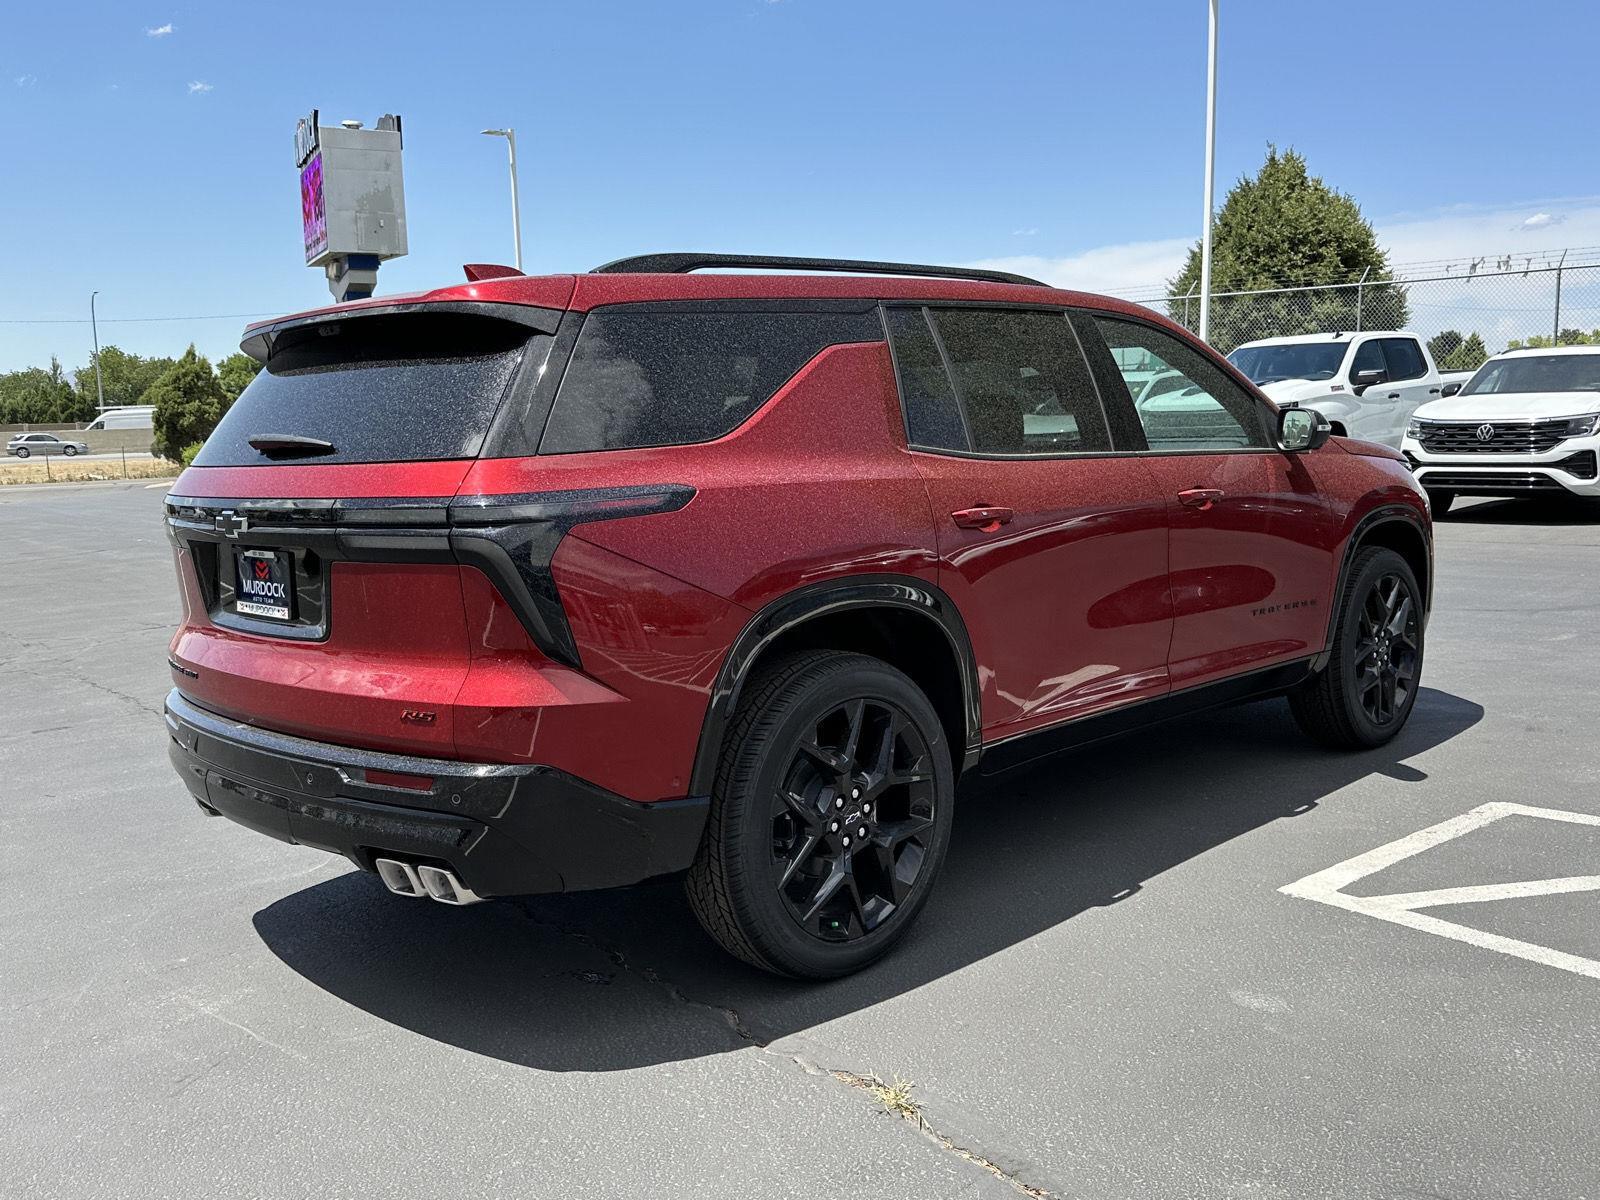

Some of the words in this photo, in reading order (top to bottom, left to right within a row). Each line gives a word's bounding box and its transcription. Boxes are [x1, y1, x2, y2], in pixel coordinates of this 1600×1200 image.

[1476, 423, 1494, 441] VW
[243, 579, 285, 598] MURDOCK
[1252, 599, 1317, 616] TRAVERSE
[400, 709, 437, 722] RS
